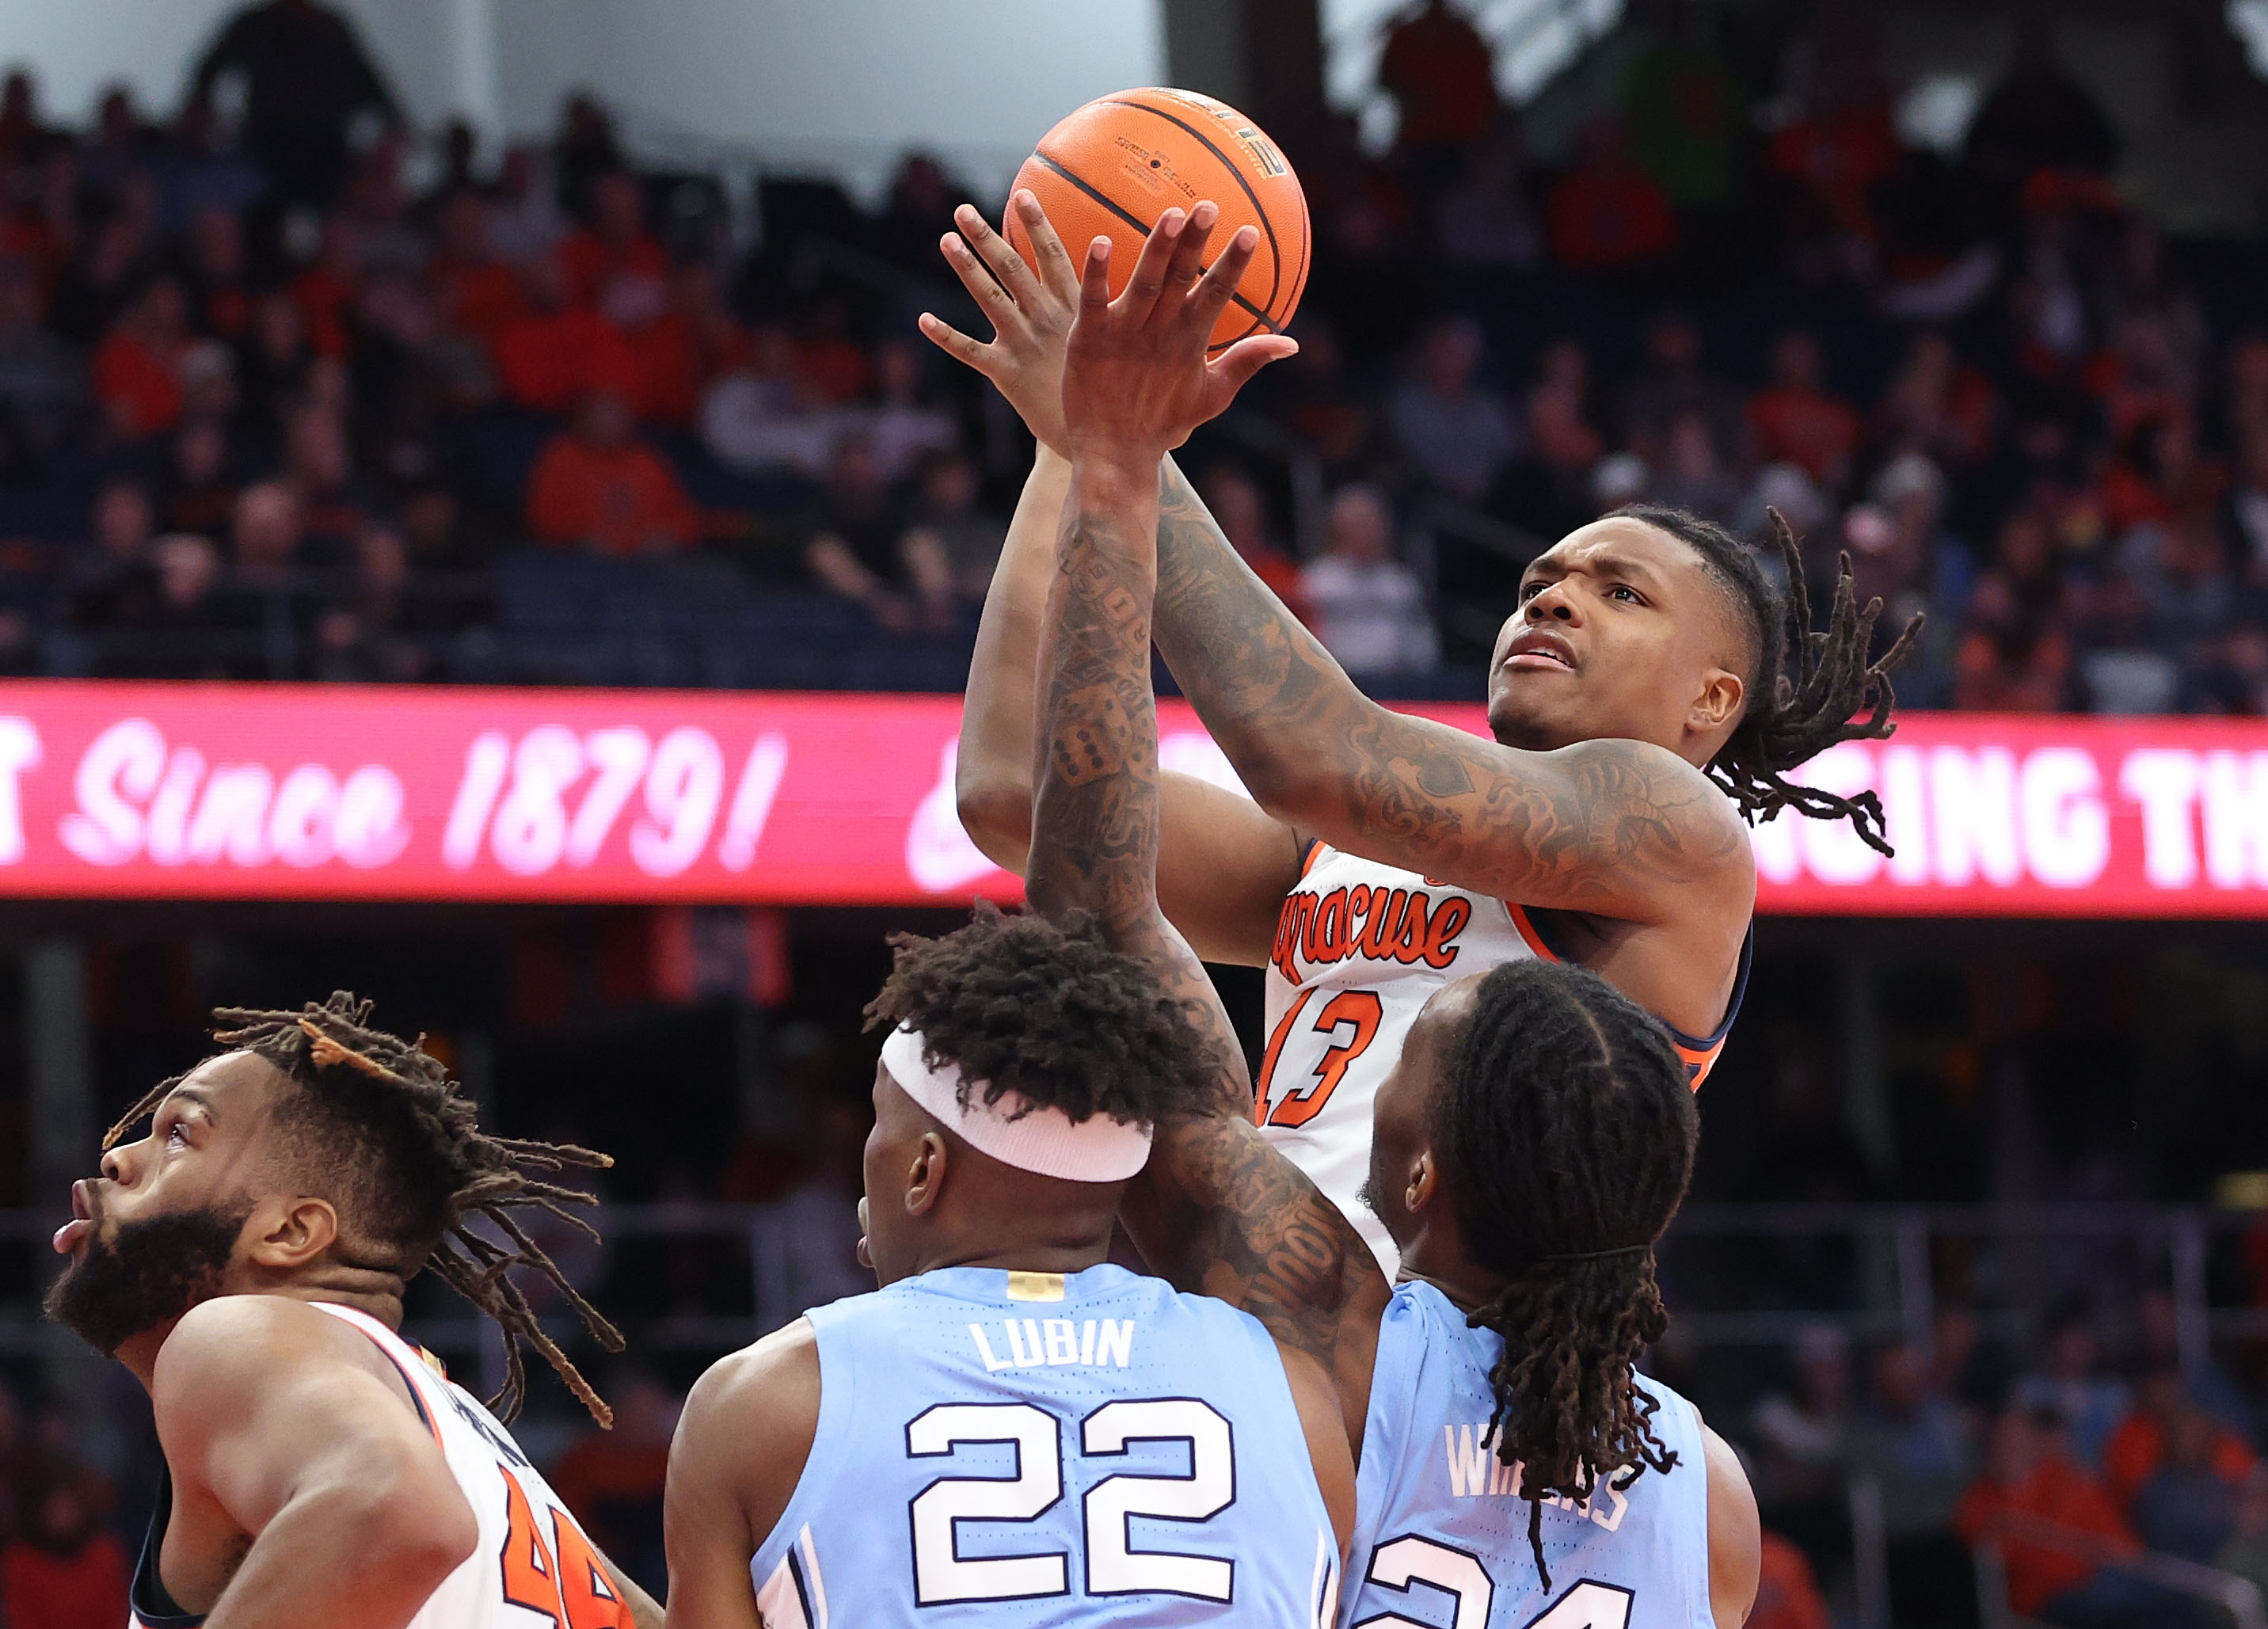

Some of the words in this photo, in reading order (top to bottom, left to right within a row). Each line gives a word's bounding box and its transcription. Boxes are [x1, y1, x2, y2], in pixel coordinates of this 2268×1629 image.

[58, 717, 409, 866] Since
[441, 724, 787, 876] 1879!
[1272, 883, 1471, 985] yracuse
[1254, 986, 1383, 1129] 13
[968, 1318, 1135, 1372] LUBIN
[904, 1397, 1236, 1607] 22
